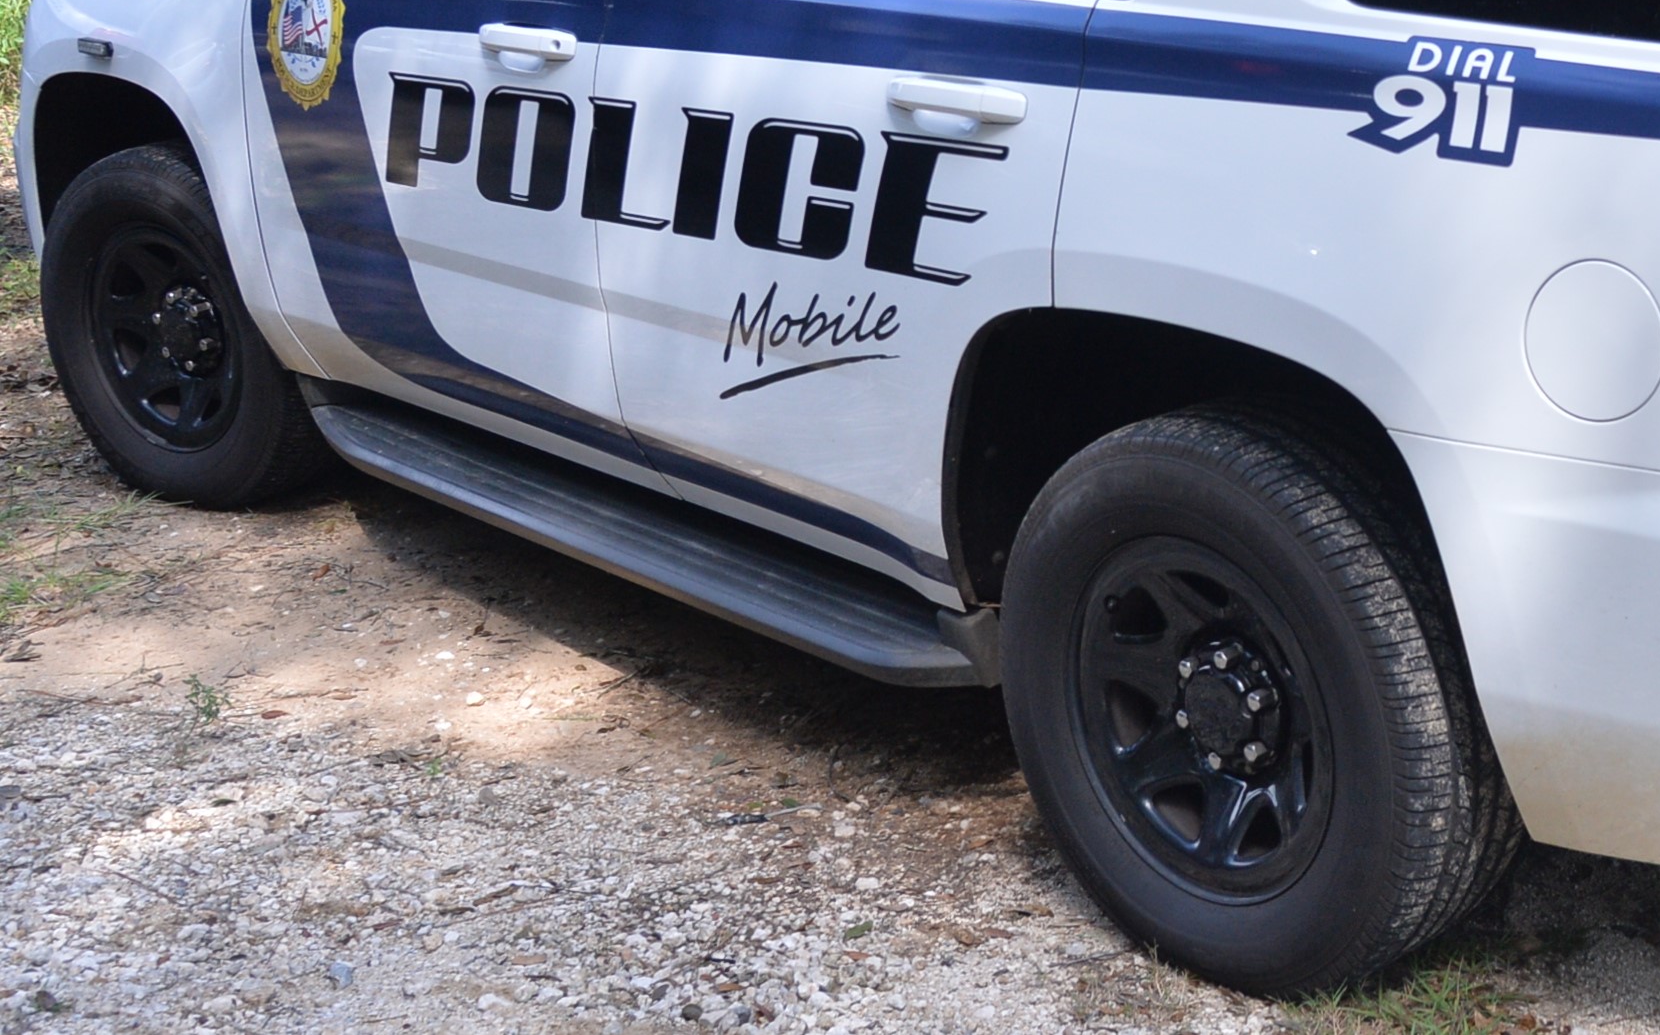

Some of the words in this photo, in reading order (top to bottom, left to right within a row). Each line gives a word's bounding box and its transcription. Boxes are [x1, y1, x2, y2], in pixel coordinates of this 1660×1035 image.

[1407, 41, 1516, 83] DIAL
[1372, 74, 1514, 154] 911
[385, 71, 1010, 287] POLICE
[722, 281, 901, 366] Mobile
